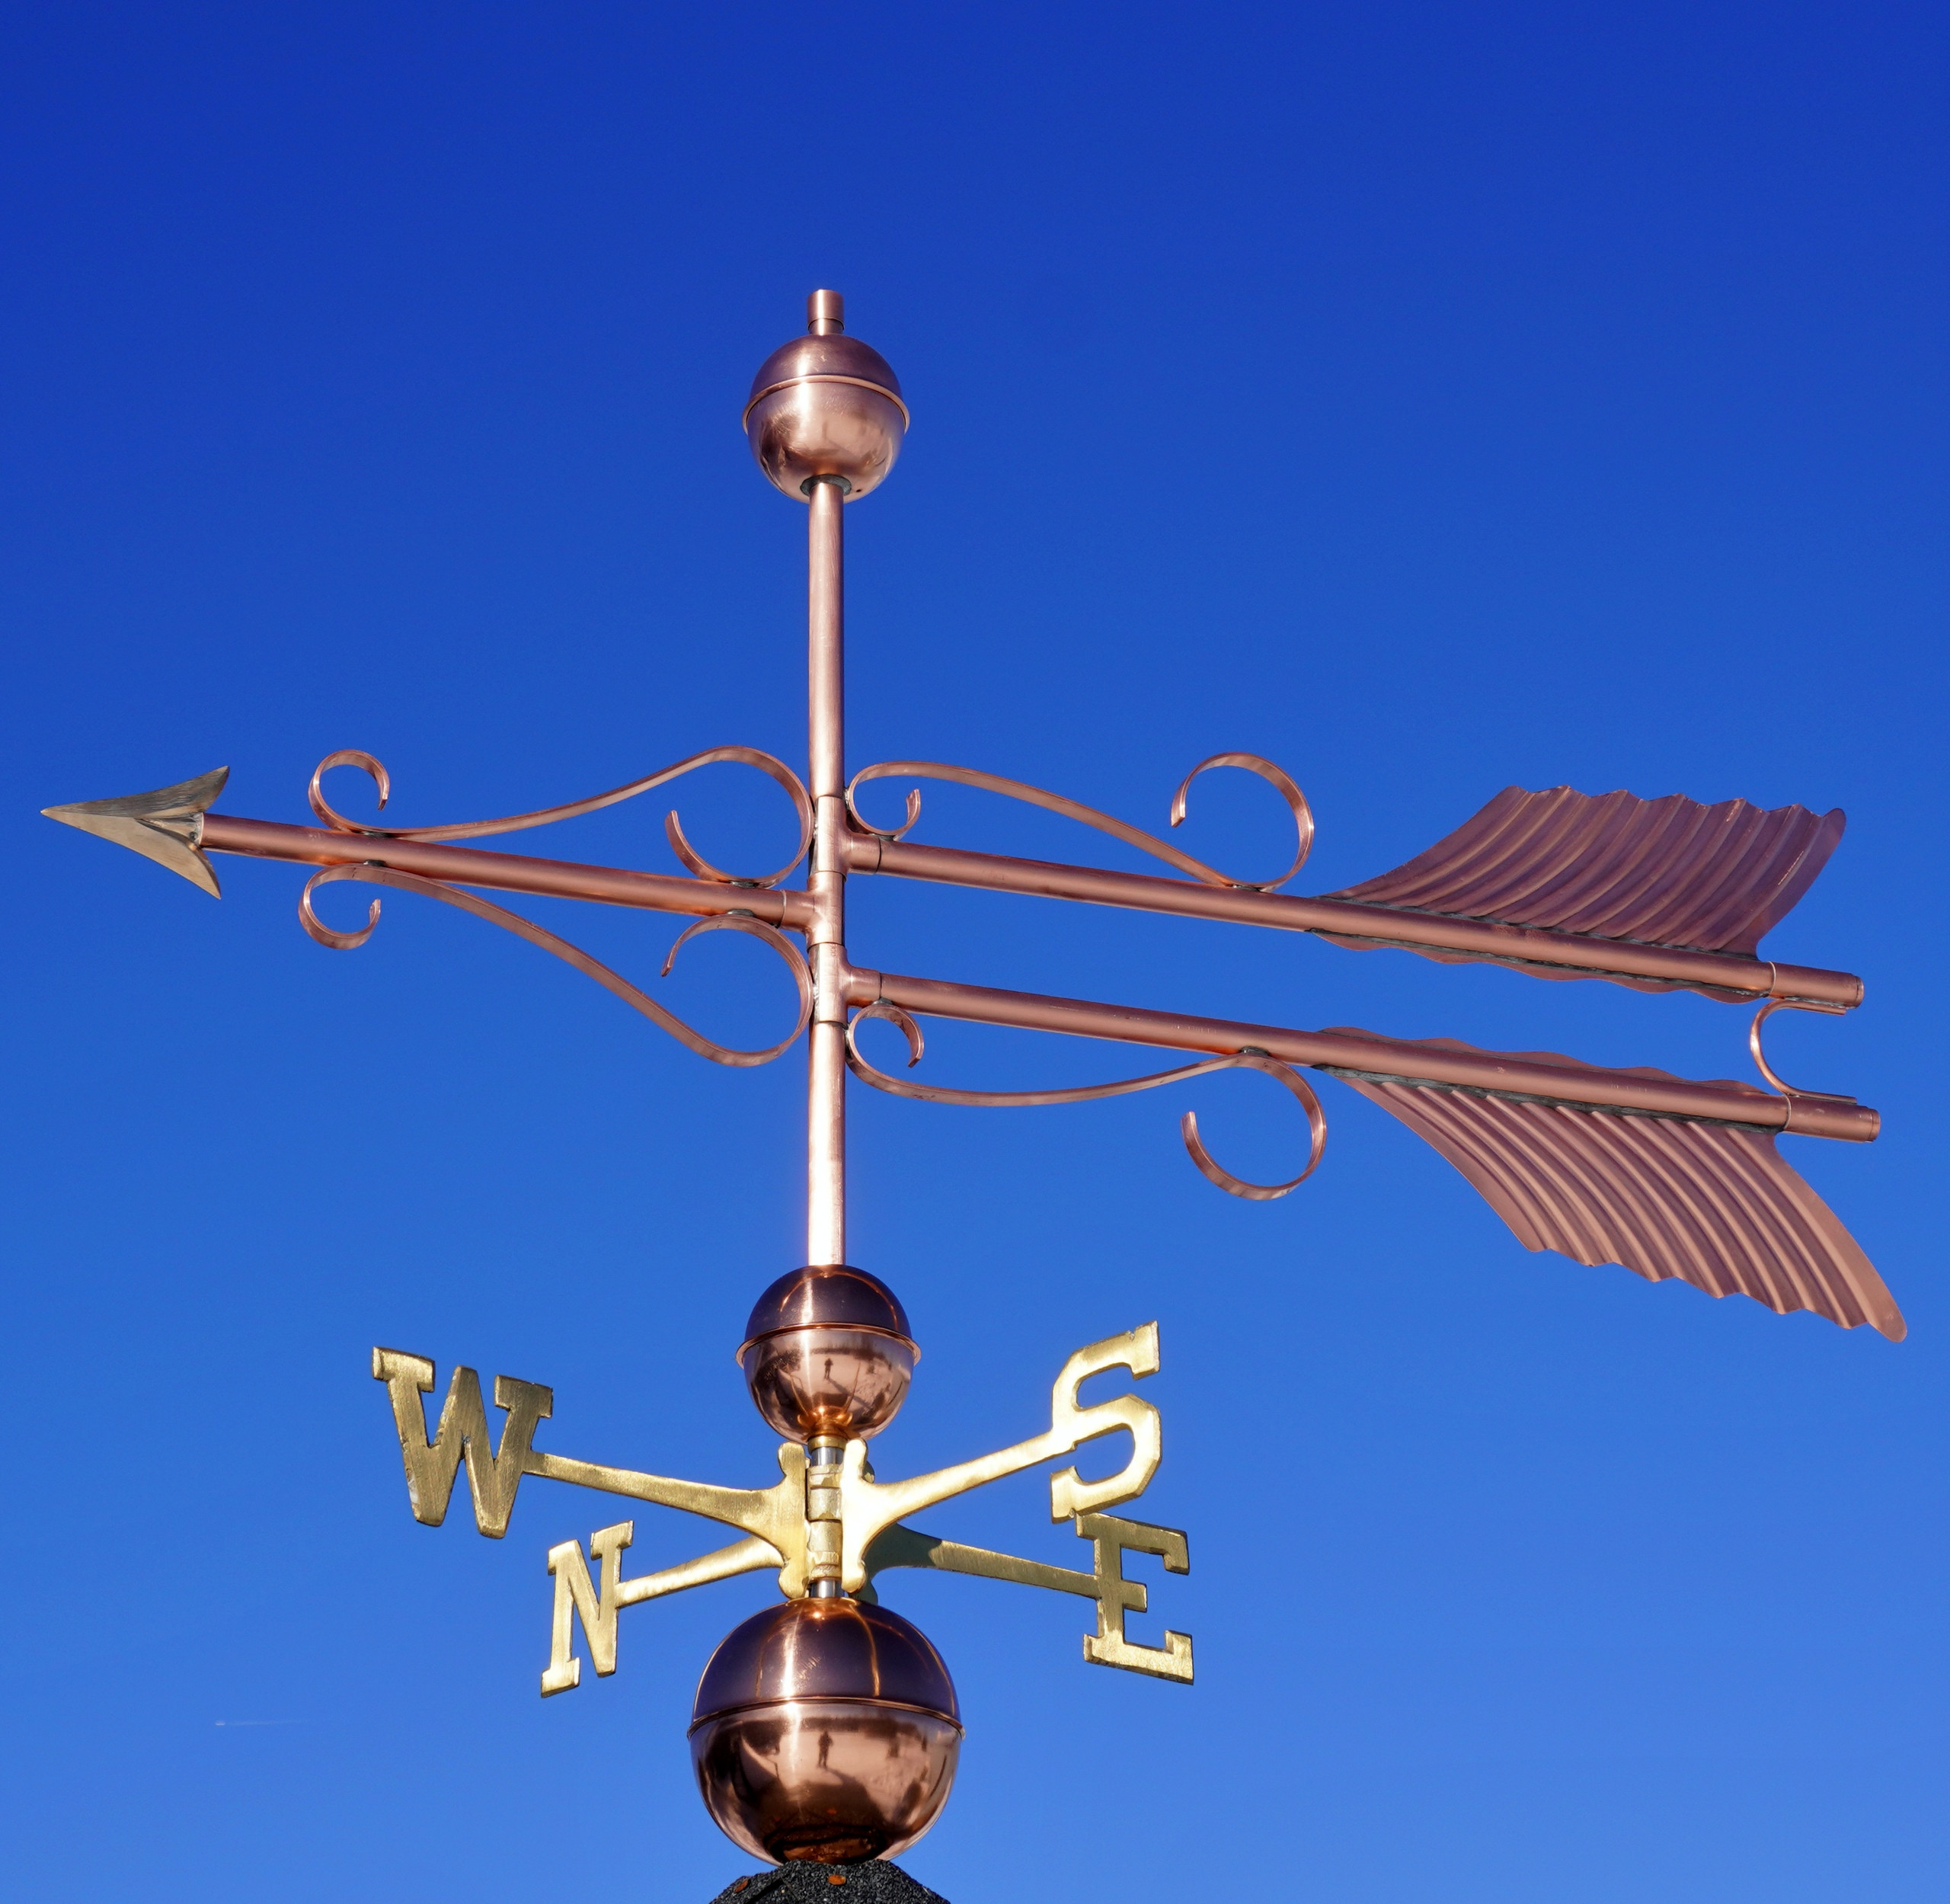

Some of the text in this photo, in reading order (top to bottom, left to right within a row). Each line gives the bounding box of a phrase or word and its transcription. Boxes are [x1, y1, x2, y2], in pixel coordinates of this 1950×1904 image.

[372, 1346, 553, 1540] W
[1050, 1320, 1162, 1524] S
[540, 1520, 634, 1698] N
[1076, 1512, 1194, 1685] E
